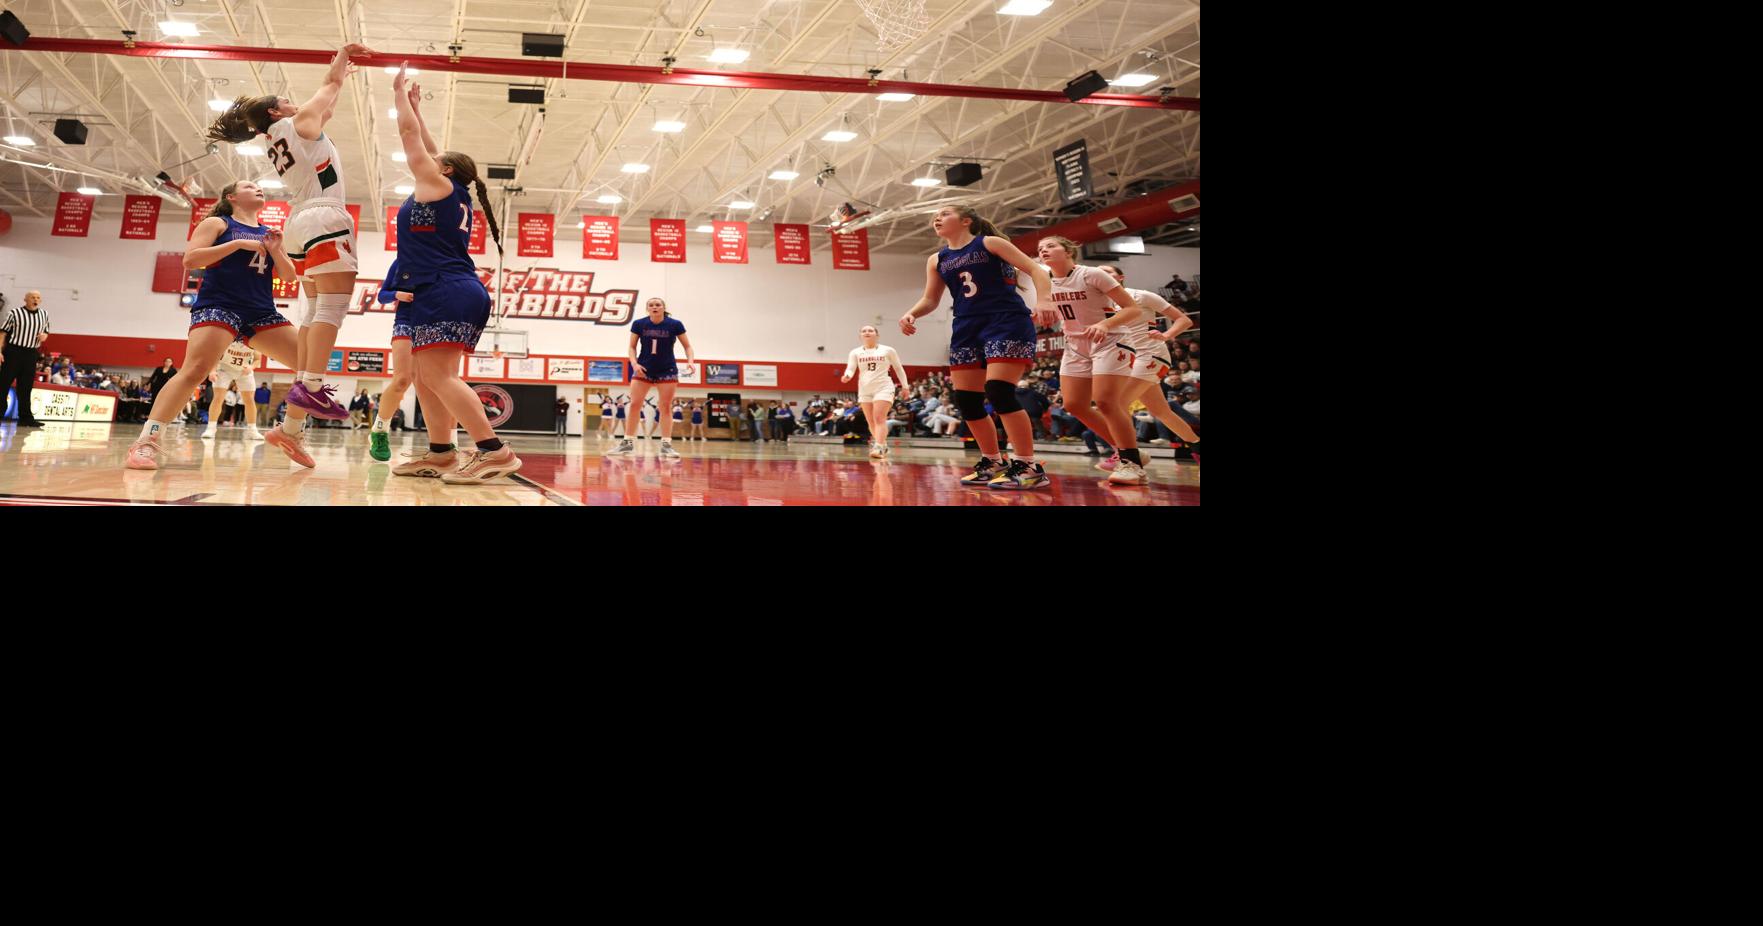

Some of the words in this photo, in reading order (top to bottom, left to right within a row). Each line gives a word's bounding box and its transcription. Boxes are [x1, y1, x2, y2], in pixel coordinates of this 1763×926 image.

[267, 138, 296, 177] 23
[248, 251, 268, 274] 4
[531, 270, 591, 292] THE
[959, 271, 978, 298] 3
[1058, 304, 1075, 320] 10
[651, 339, 658, 354] 1
[231, 357, 243, 366] 33
[868, 362, 876, 371] 13
